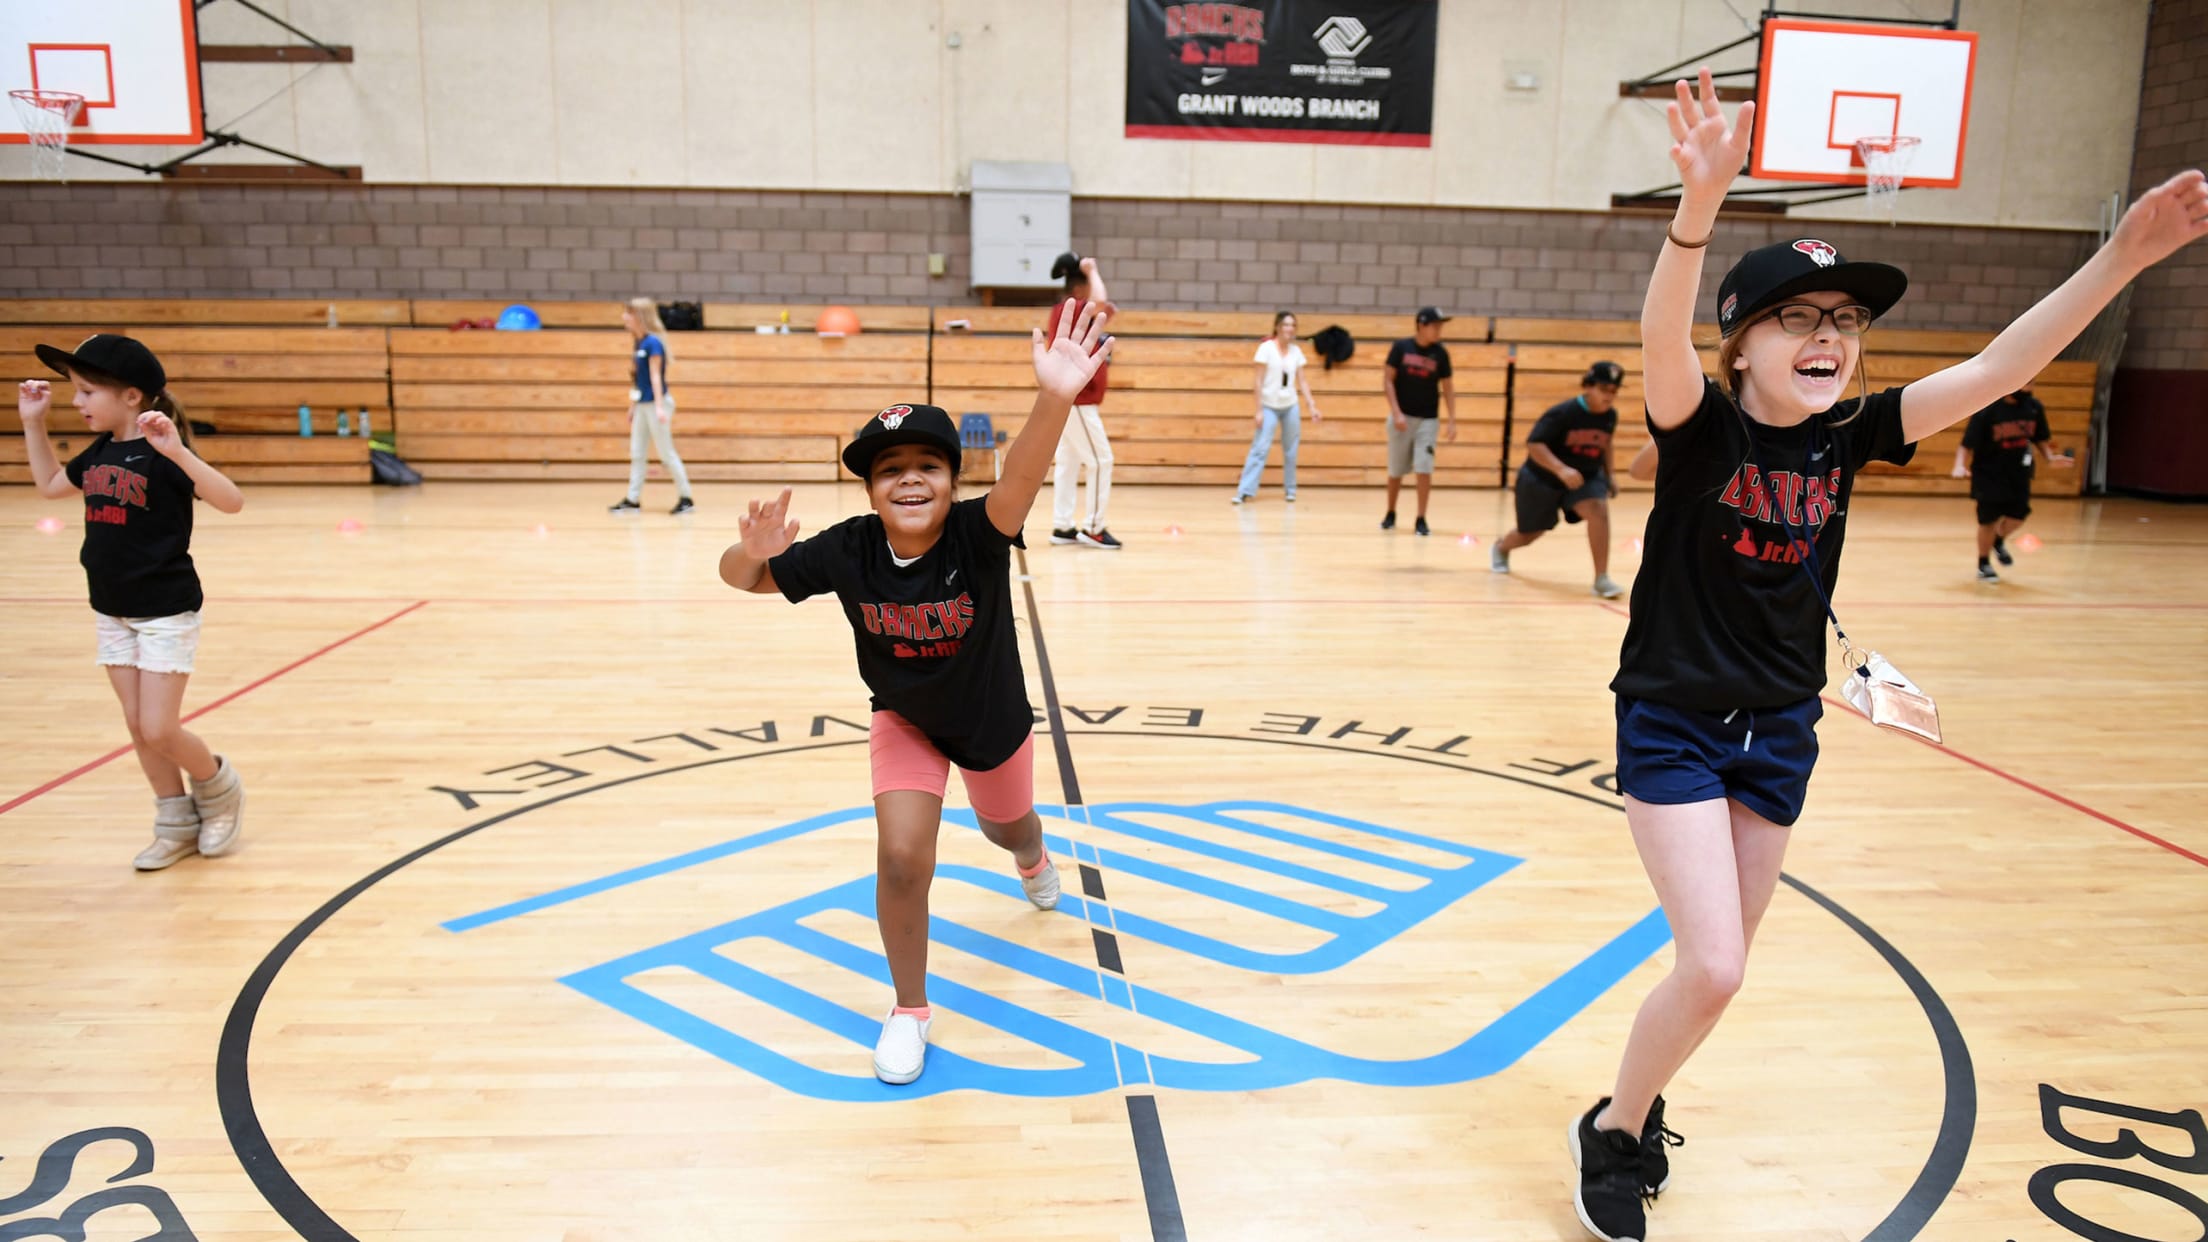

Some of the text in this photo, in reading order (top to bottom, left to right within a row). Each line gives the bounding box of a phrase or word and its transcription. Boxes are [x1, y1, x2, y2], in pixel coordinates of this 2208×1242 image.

[1178, 93, 1380, 120] GRANT WOODS BRANCH
[859, 592, 975, 641] D-BACKS
[1250, 712, 1471, 757] THE
[428, 715, 870, 811] VALLEY
